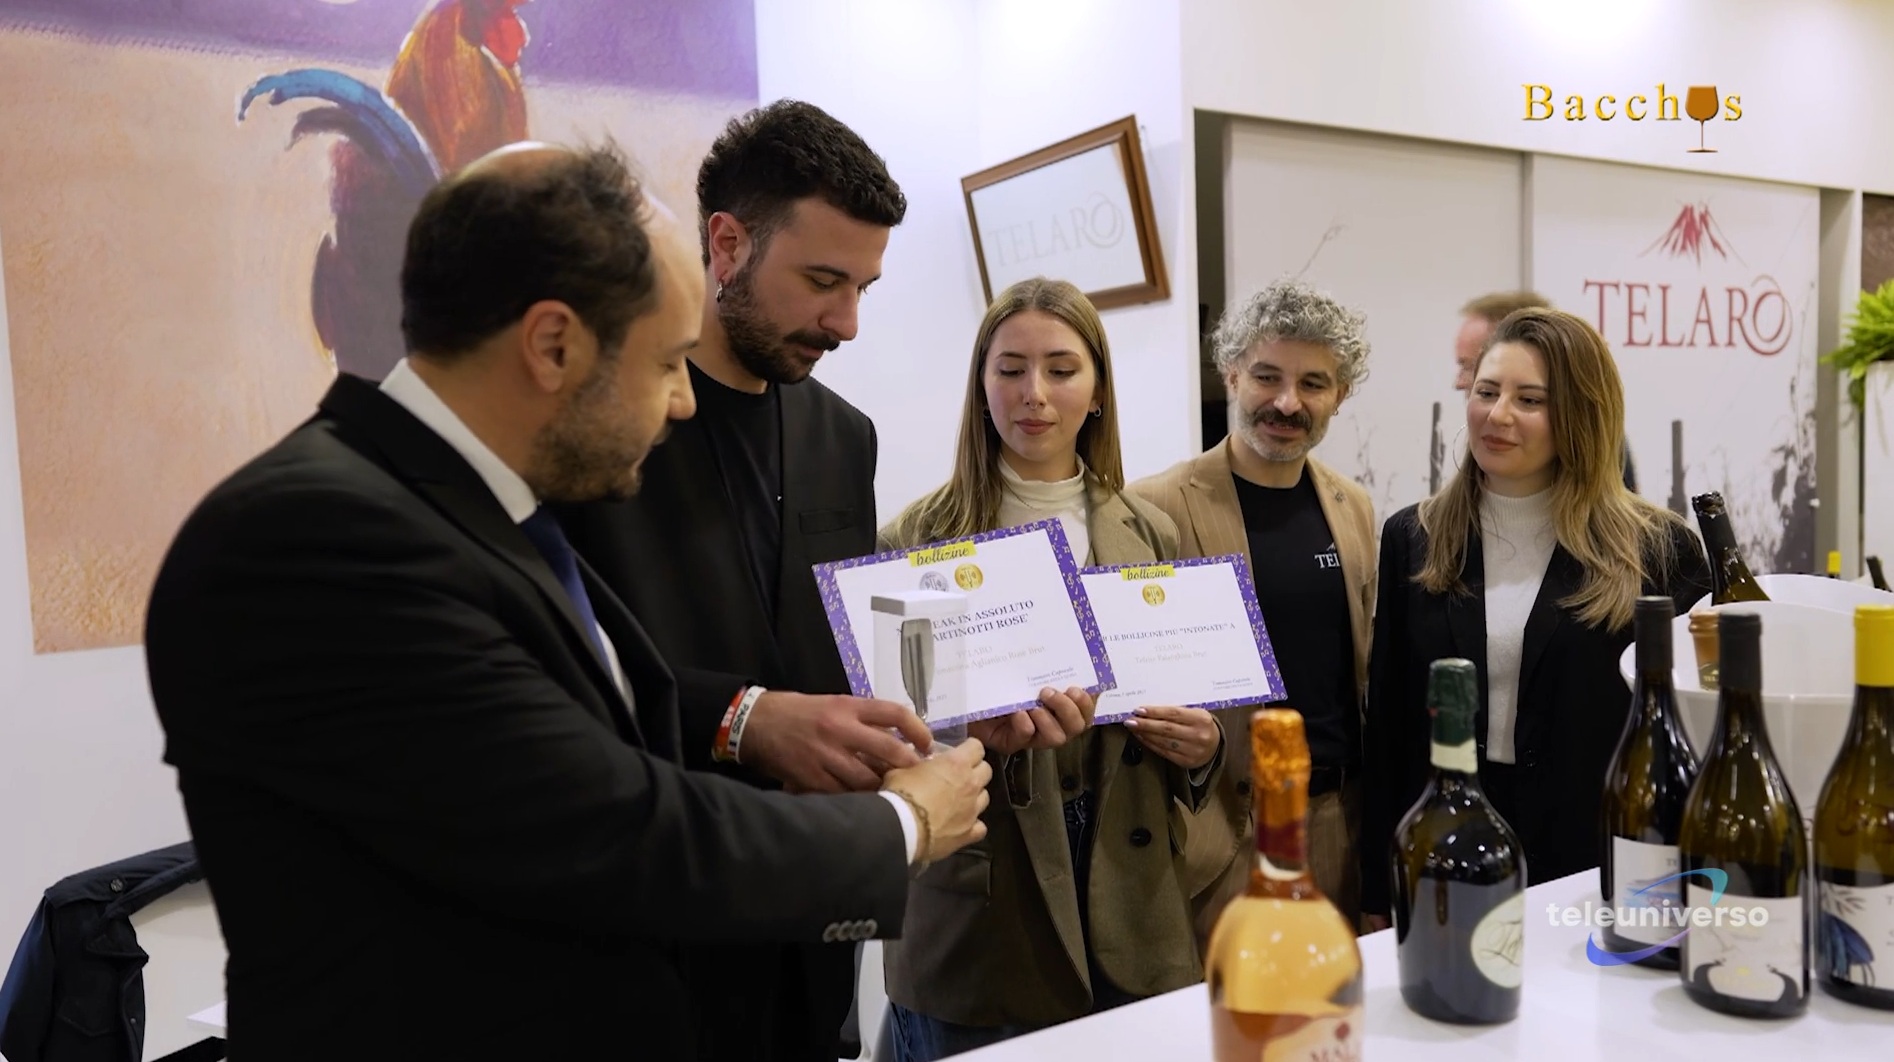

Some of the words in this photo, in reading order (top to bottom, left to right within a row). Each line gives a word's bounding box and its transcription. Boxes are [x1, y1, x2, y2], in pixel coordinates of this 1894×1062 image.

[1583, 274, 1793, 356] TELARO
[916, 545, 970, 567] bollizine
[1126, 568, 1170, 581] bollizine
[974, 600, 1034, 622] ASSOLUTO
[932, 618, 994, 642] ARTINOTTI
[1121, 629, 1165, 641] BOLLICINE
